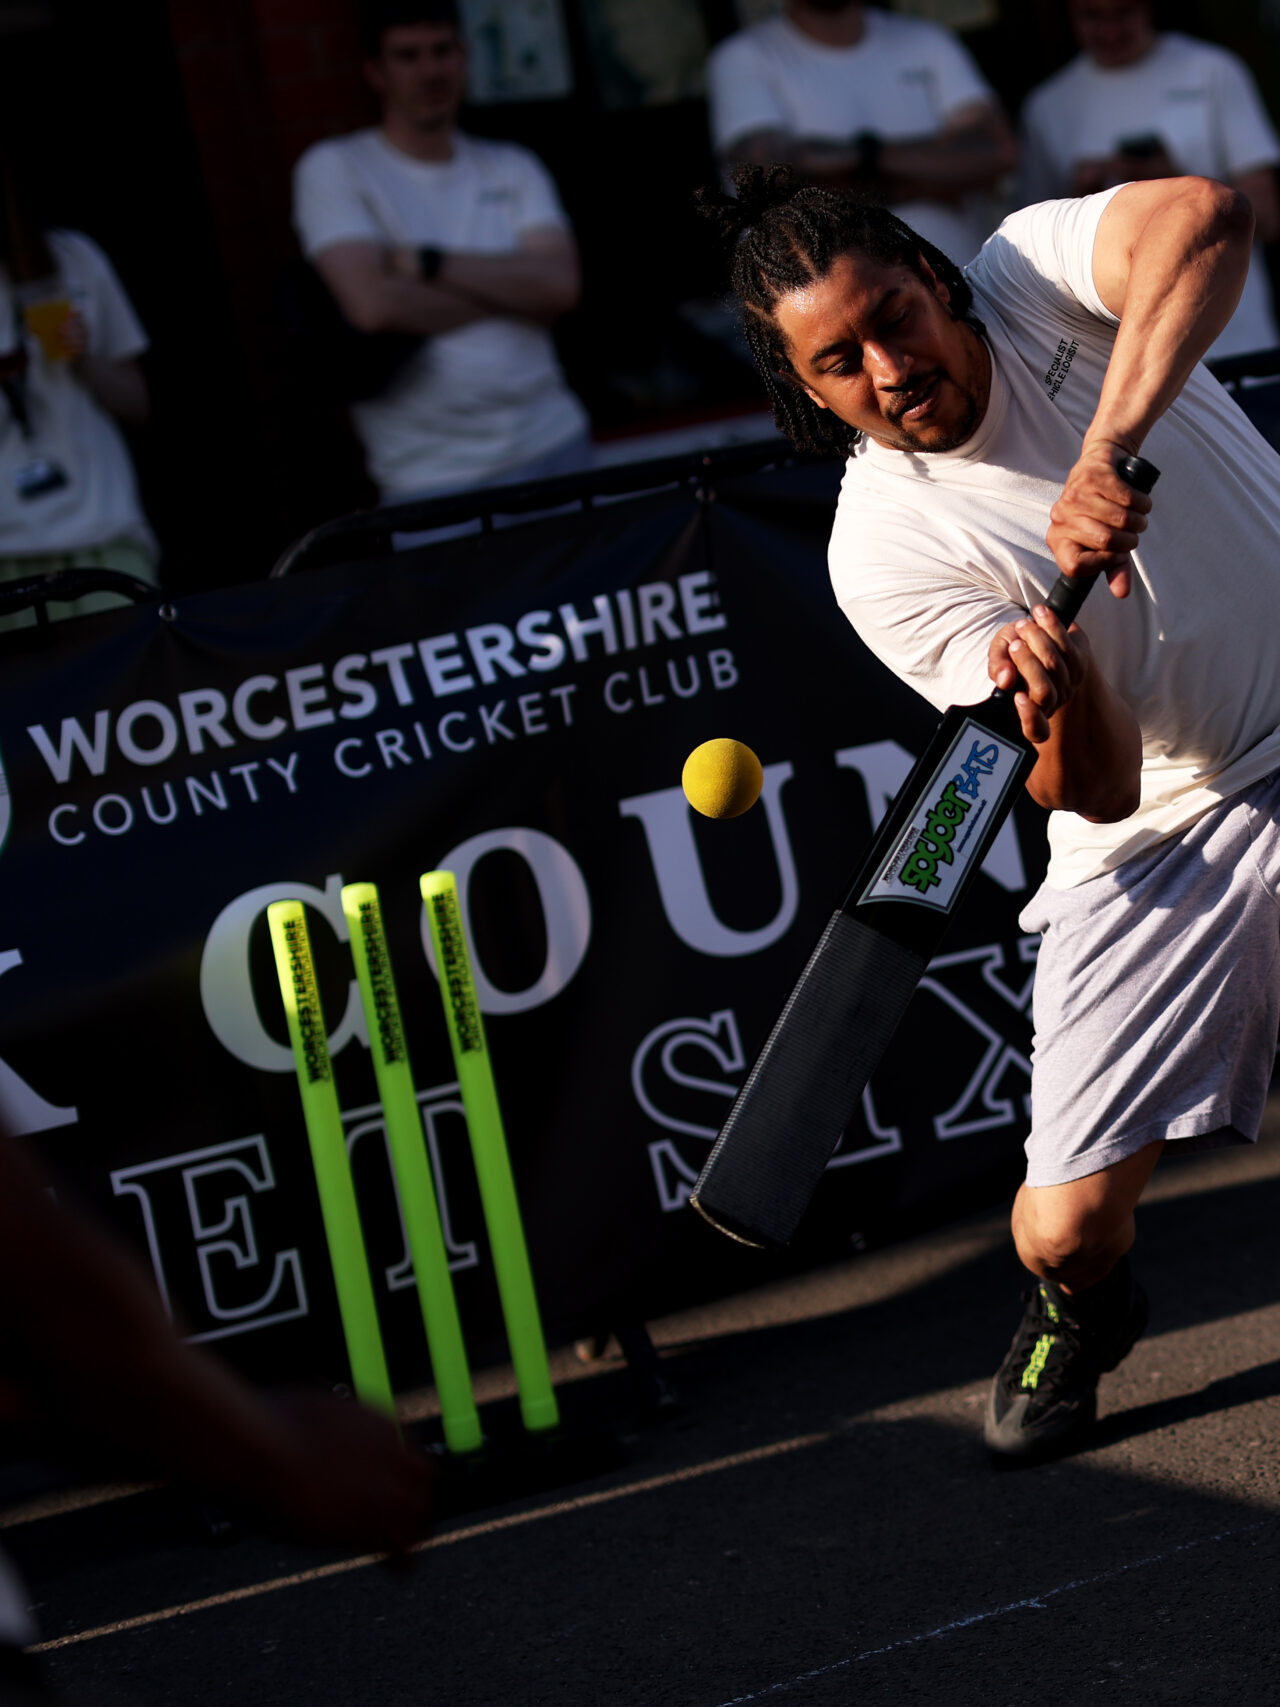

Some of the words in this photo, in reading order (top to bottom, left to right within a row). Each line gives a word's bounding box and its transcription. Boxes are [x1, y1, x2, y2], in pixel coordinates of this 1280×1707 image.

[1044, 337, 1069, 386] SPECIALIST
[1046, 371, 1067, 402] EHICLE
[26, 569, 729, 785] WORCESTERSHIRE
[48, 750, 303, 847] COUNTY
[332, 681, 582, 780] CRICKET
[602, 647, 742, 716] CLUB
[282, 919, 321, 1083] WORCESTERSHIRE
[359, 902, 397, 1064] WORCESTERSHIRE
[434, 893, 471, 1053] WORCESTERSHIRE
